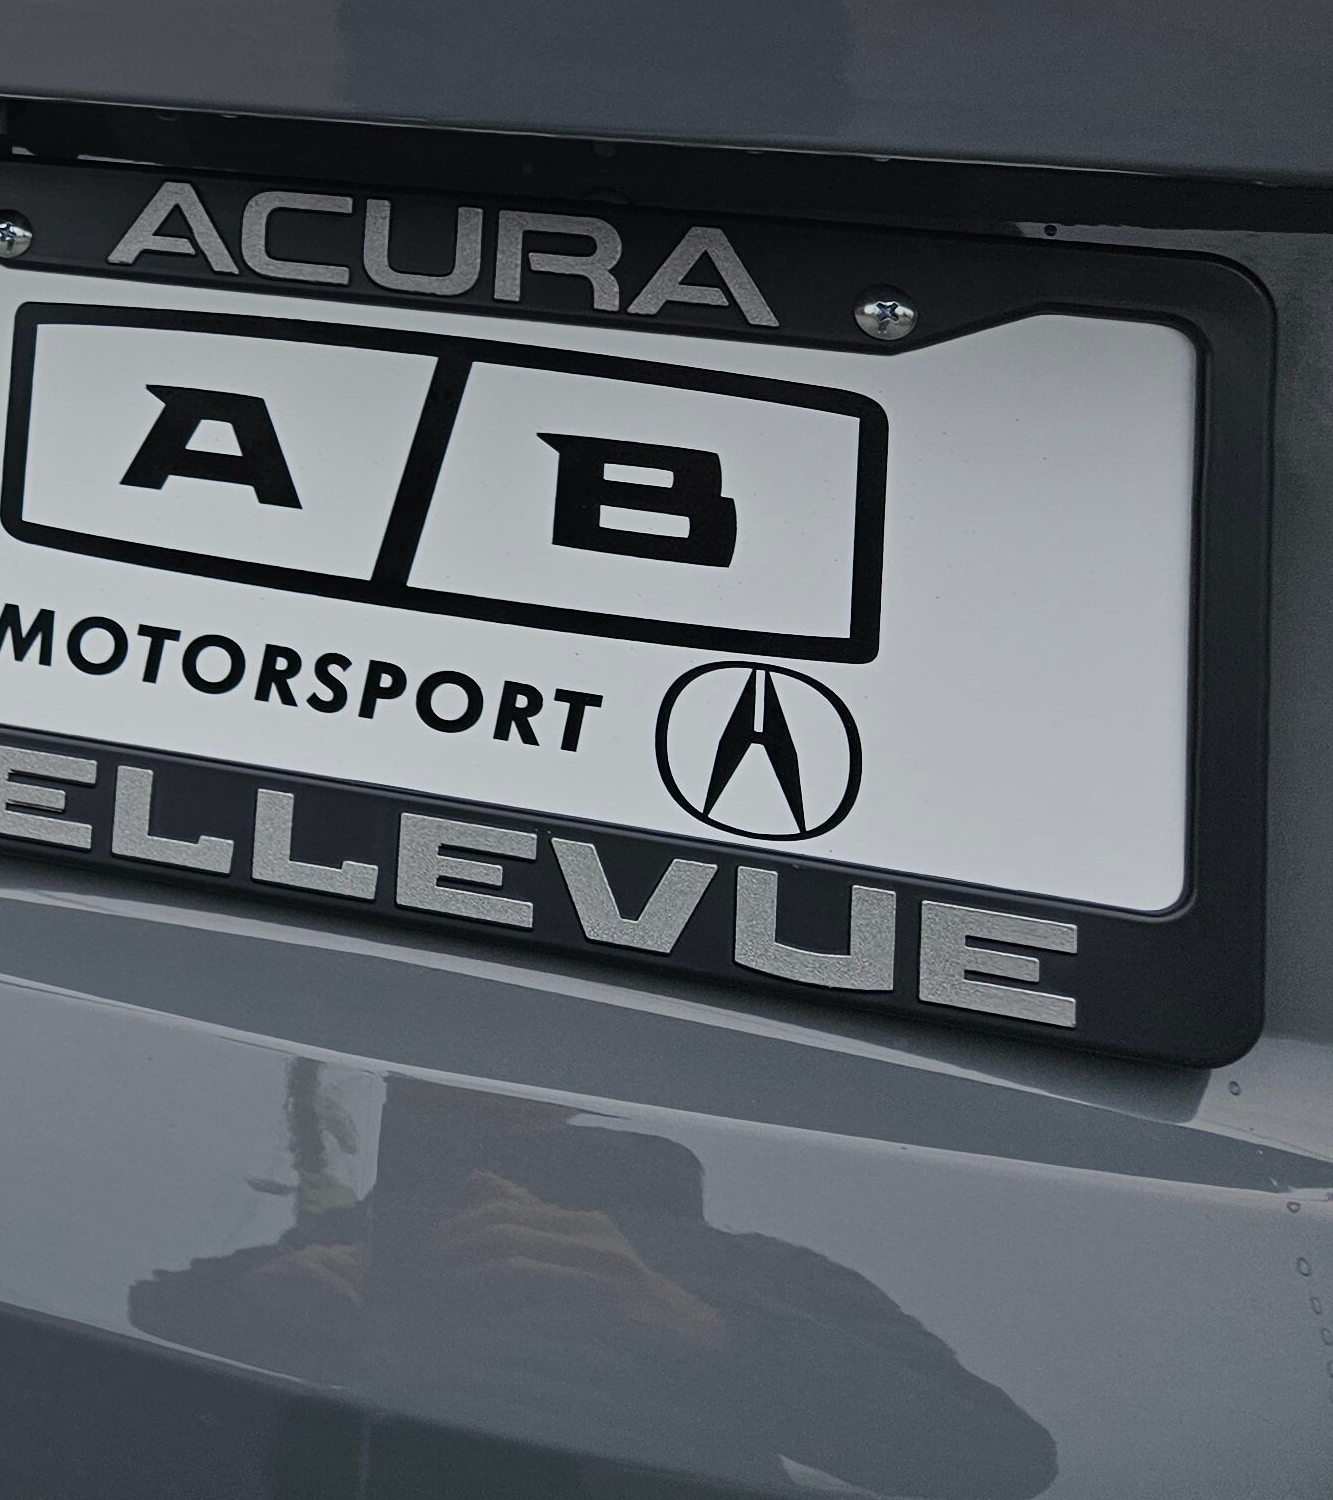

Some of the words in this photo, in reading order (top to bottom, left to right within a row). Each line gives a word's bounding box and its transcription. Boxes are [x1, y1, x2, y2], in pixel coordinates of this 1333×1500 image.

[107, 181, 779, 327] ACURA
[120, 384, 303, 509] A
[537, 432, 738, 569] B
